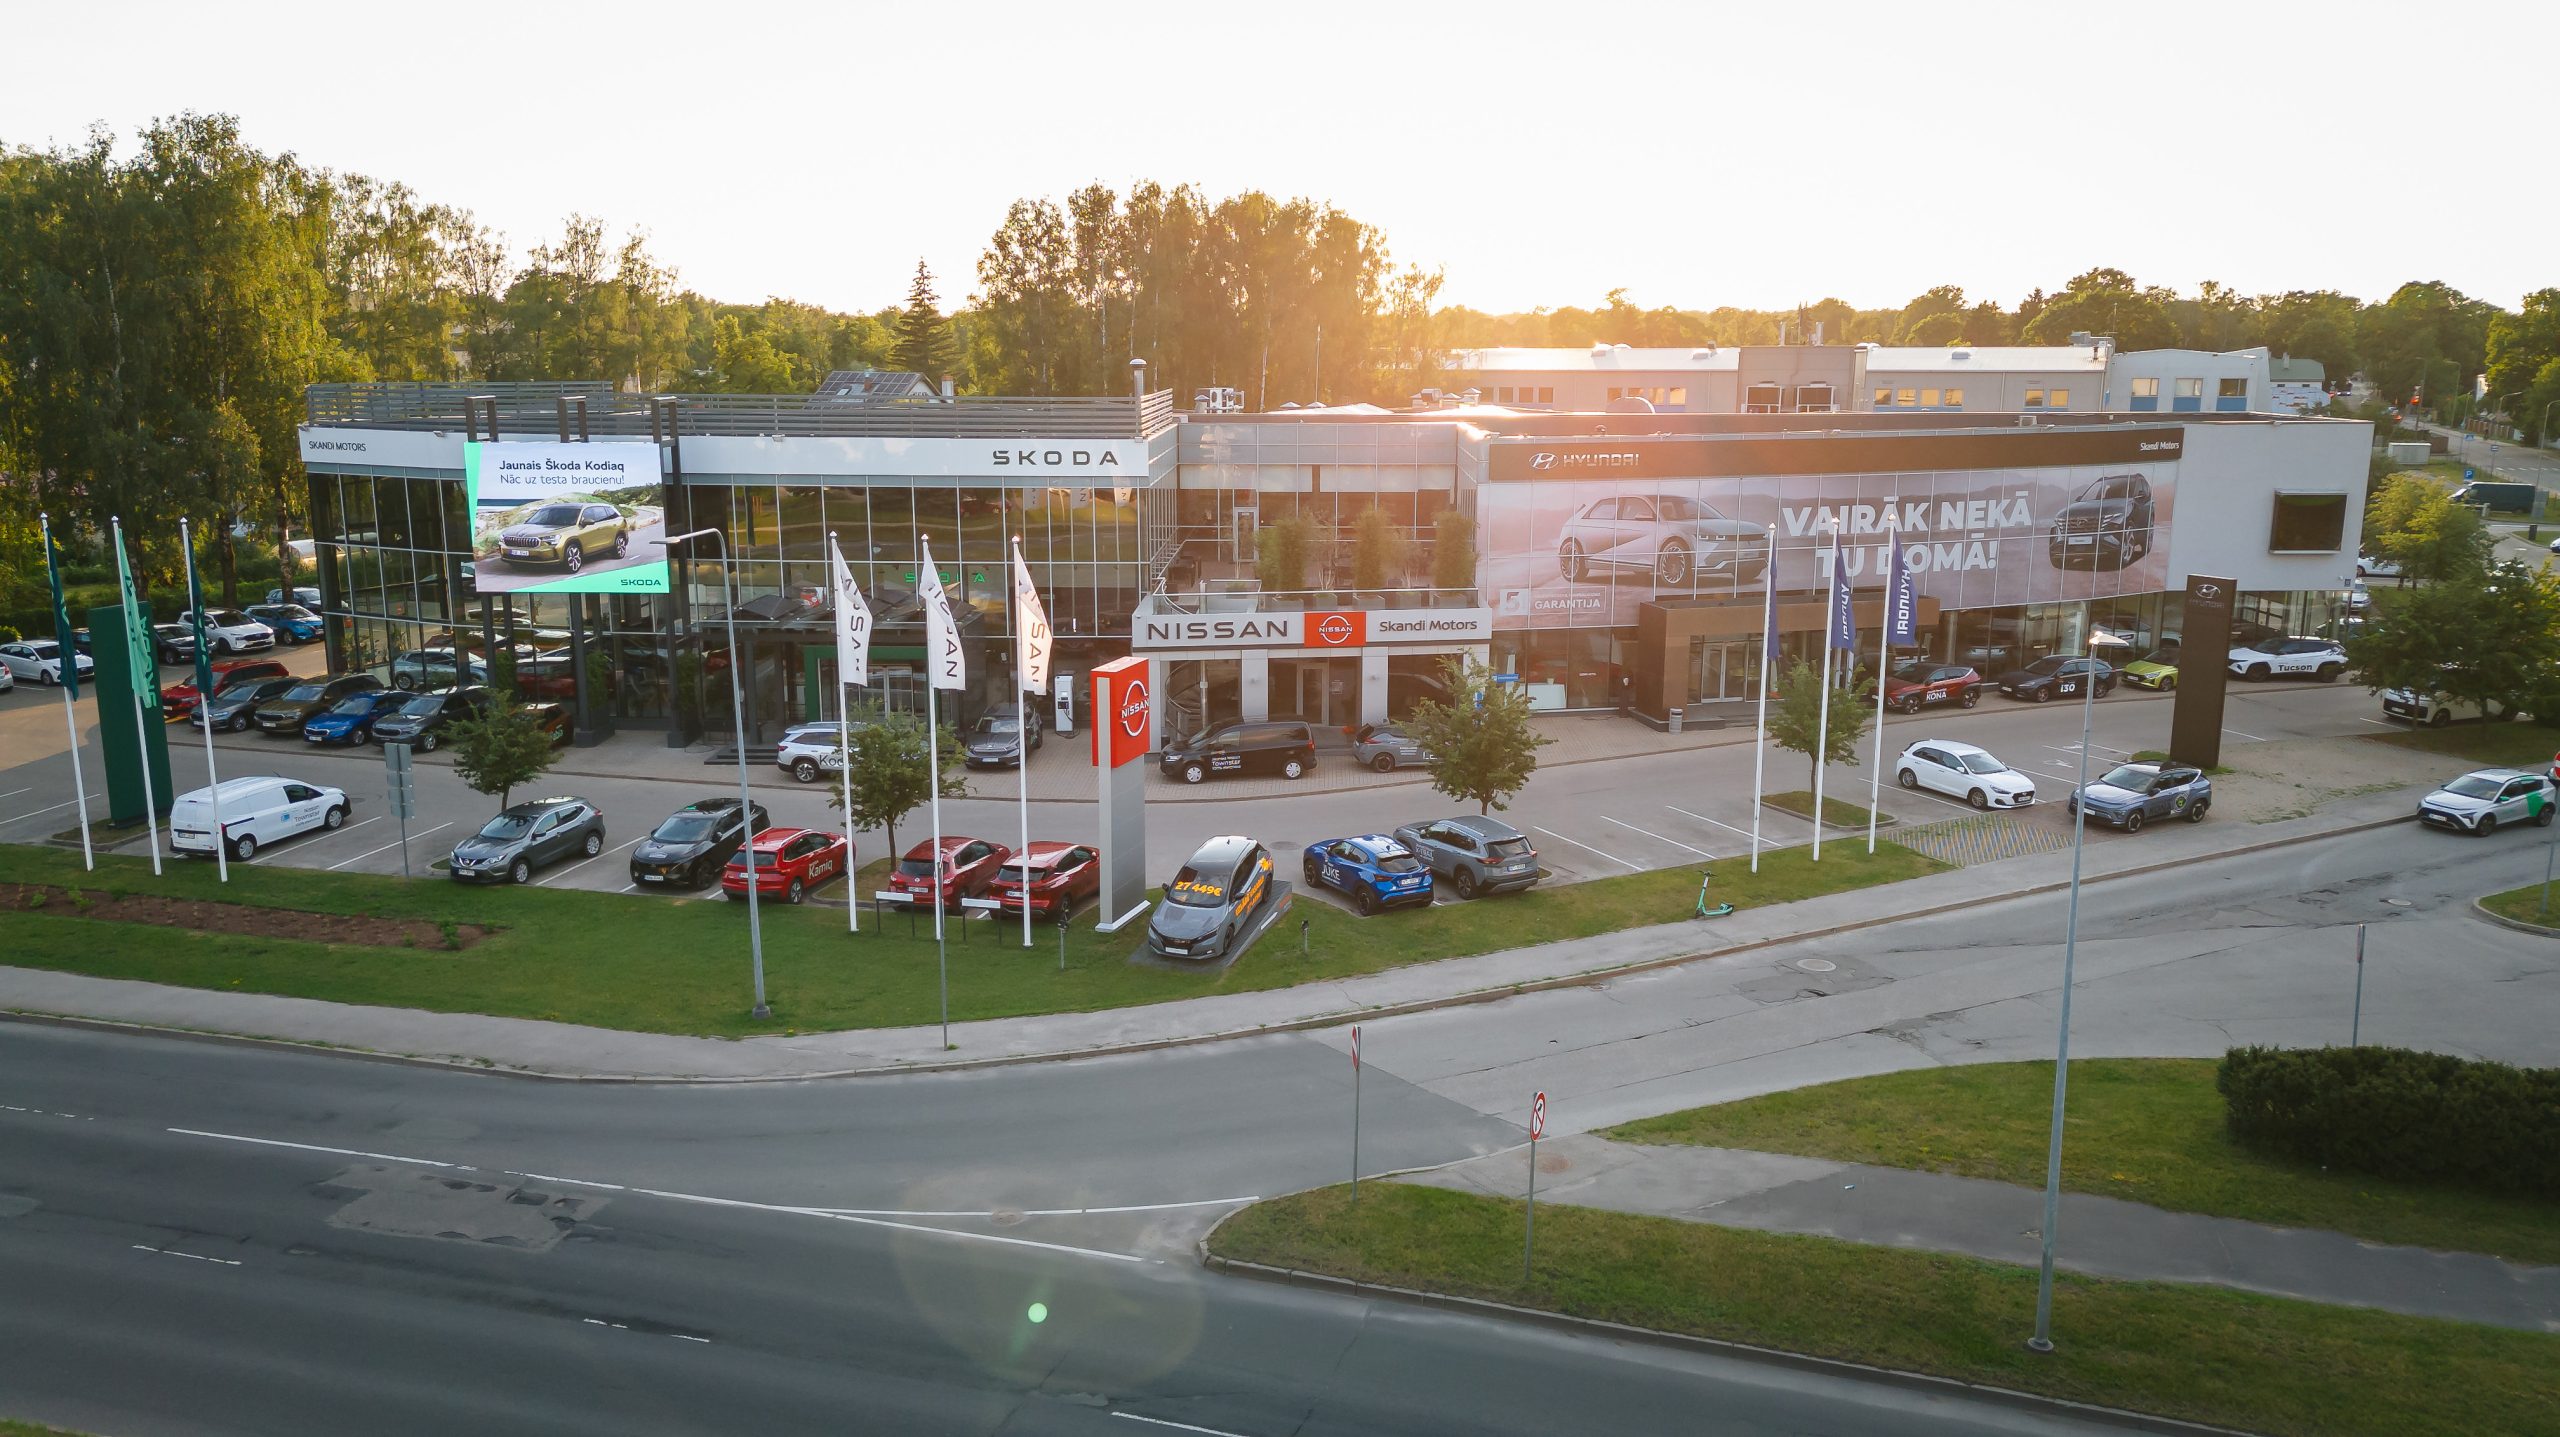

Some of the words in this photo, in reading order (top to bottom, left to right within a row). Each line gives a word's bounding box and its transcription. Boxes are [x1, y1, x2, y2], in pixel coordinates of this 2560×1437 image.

[308, 440, 335, 450] SKANDI
[335, 442, 367, 452] MOTORS
[2140, 441, 2159, 451] Skandi
[2160, 441, 2180, 450] Motors
[499, 459, 542, 471] Jaunais
[545, 457, 581, 471] Škoda
[585, 459, 625, 473] Kodiaq
[1563, 453, 1640, 467] HYUNDAI
[500, 474, 521, 485] Nāc
[525, 476, 537, 485] uz
[541, 475, 568, 485] testa
[571, 474, 625, 485] braucienu!
[1782, 495, 1930, 537] VAIRĀK
[1939, 490, 2033, 535] NEKĀ
[1534, 599, 1601, 610] GARANTIJA
[1147, 620, 1288, 640] NISSAN
[1379, 620, 1426, 632] Skandi
[1429, 619, 1478, 631] Motors
[2278, 664, 2313, 672] Tucson
[1121, 699, 1150, 719] NISSAN
[808, 859, 833, 880] Kamiq
[1321, 864, 1341, 881] JUKE
[1175, 881, 1193, 891] 27
[1192, 882, 1223, 897] 449€
